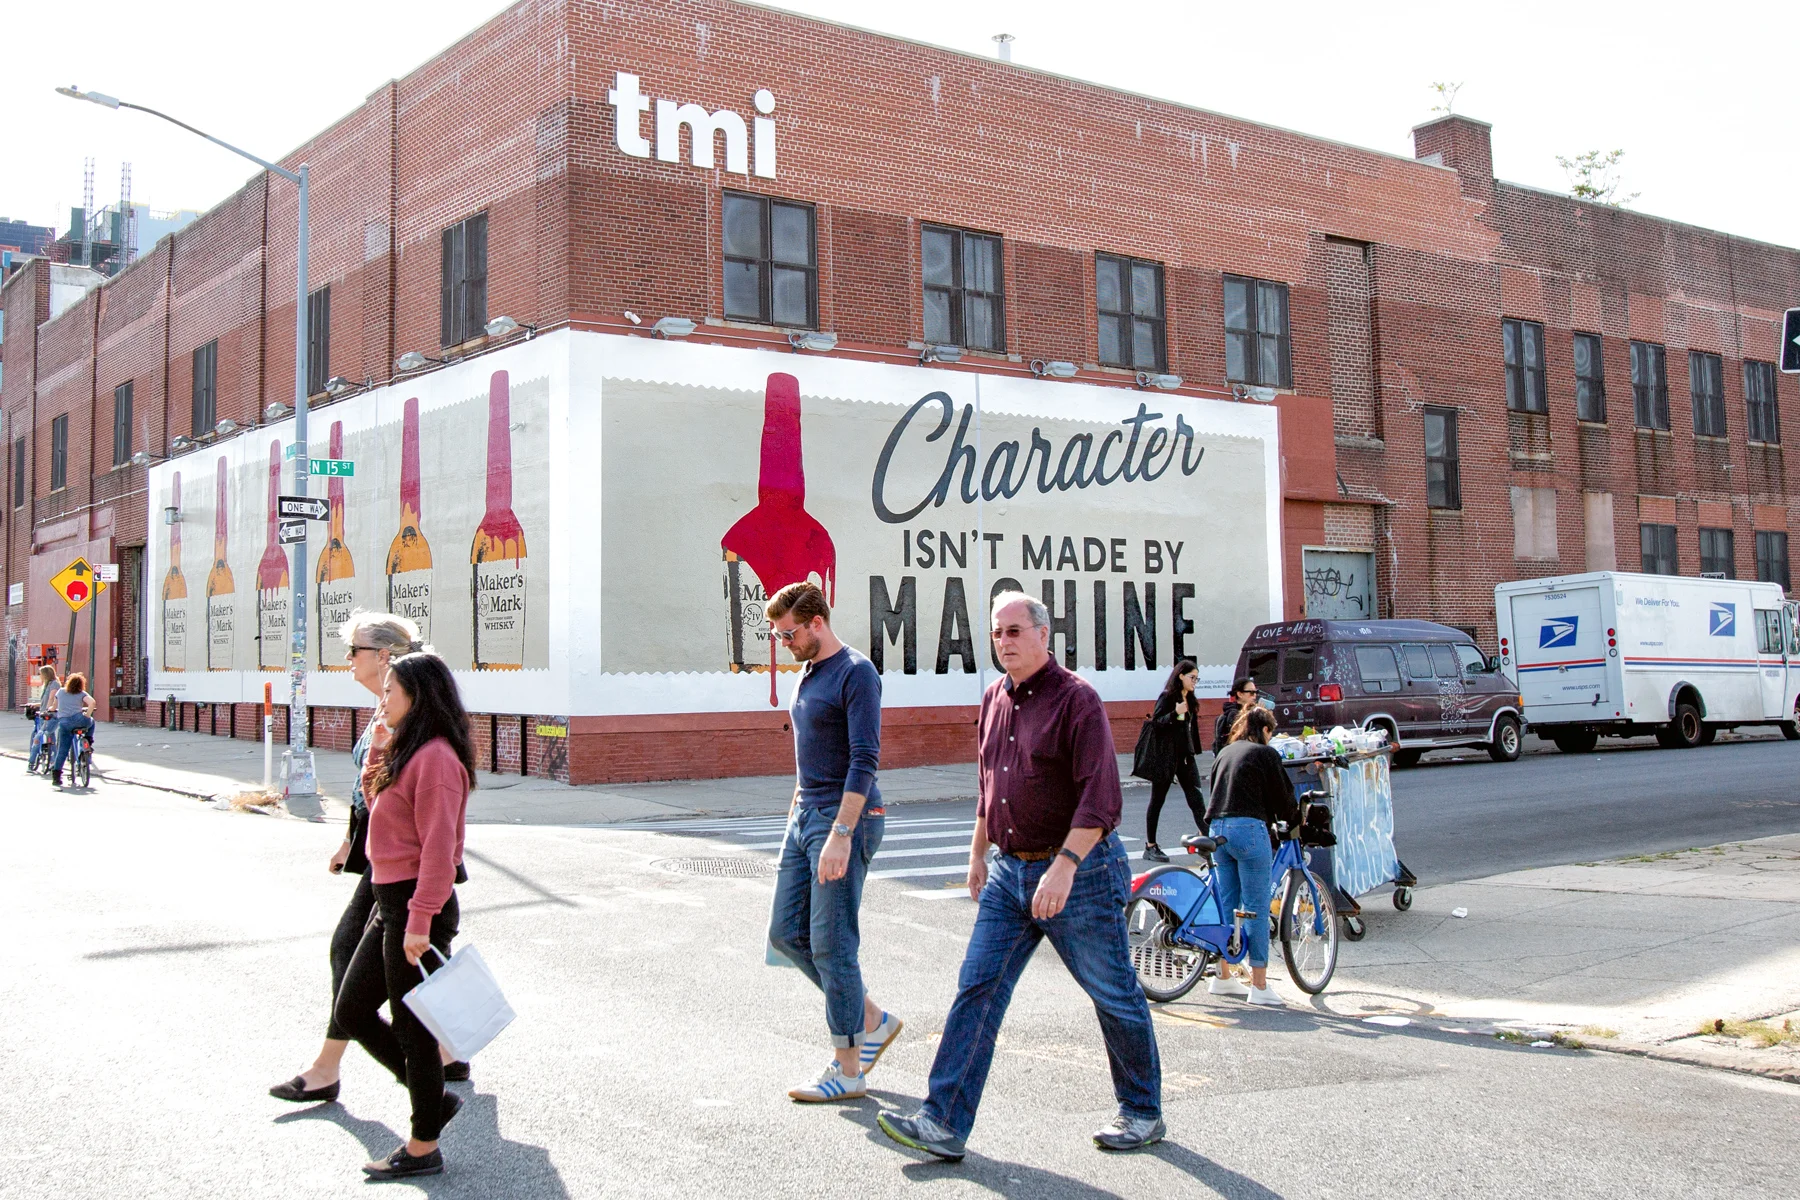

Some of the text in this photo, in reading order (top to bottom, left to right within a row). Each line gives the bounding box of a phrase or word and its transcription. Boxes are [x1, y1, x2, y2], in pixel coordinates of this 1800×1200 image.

[608, 71, 776, 179] tmi
[872, 391, 1204, 523] Character
[312, 461, 320, 473] N
[326, 462, 338, 474] 15
[287, 503, 323, 514] ONE WAY
[281, 525, 304, 537] ONE WAY
[903, 529, 1185, 575] ISN'T MADE BY
[479, 574, 523, 591] Maker's
[392, 583, 429, 600] Maker's
[261, 599, 287, 611] Maker's
[321, 591, 352, 606] Maker's
[490, 594, 522, 612] Mark
[1635, 597, 1643, 605] We
[1644, 597, 1661, 606] Deliver
[166, 608, 185, 619] Maker's
[211, 604, 233, 617] Maker's
[330, 608, 351, 623] Mark
[403, 602, 429, 619] Mark
[216, 619, 232, 632] Mark
[268, 614, 286, 627] Mark
[484, 621, 515, 630] WHISKY
[869, 575, 1198, 675] MAHINE
[171, 622, 185, 633] Mark
[1256, 627, 1283, 640] LOVE
[1150, 885, 1177, 896] citi bike
